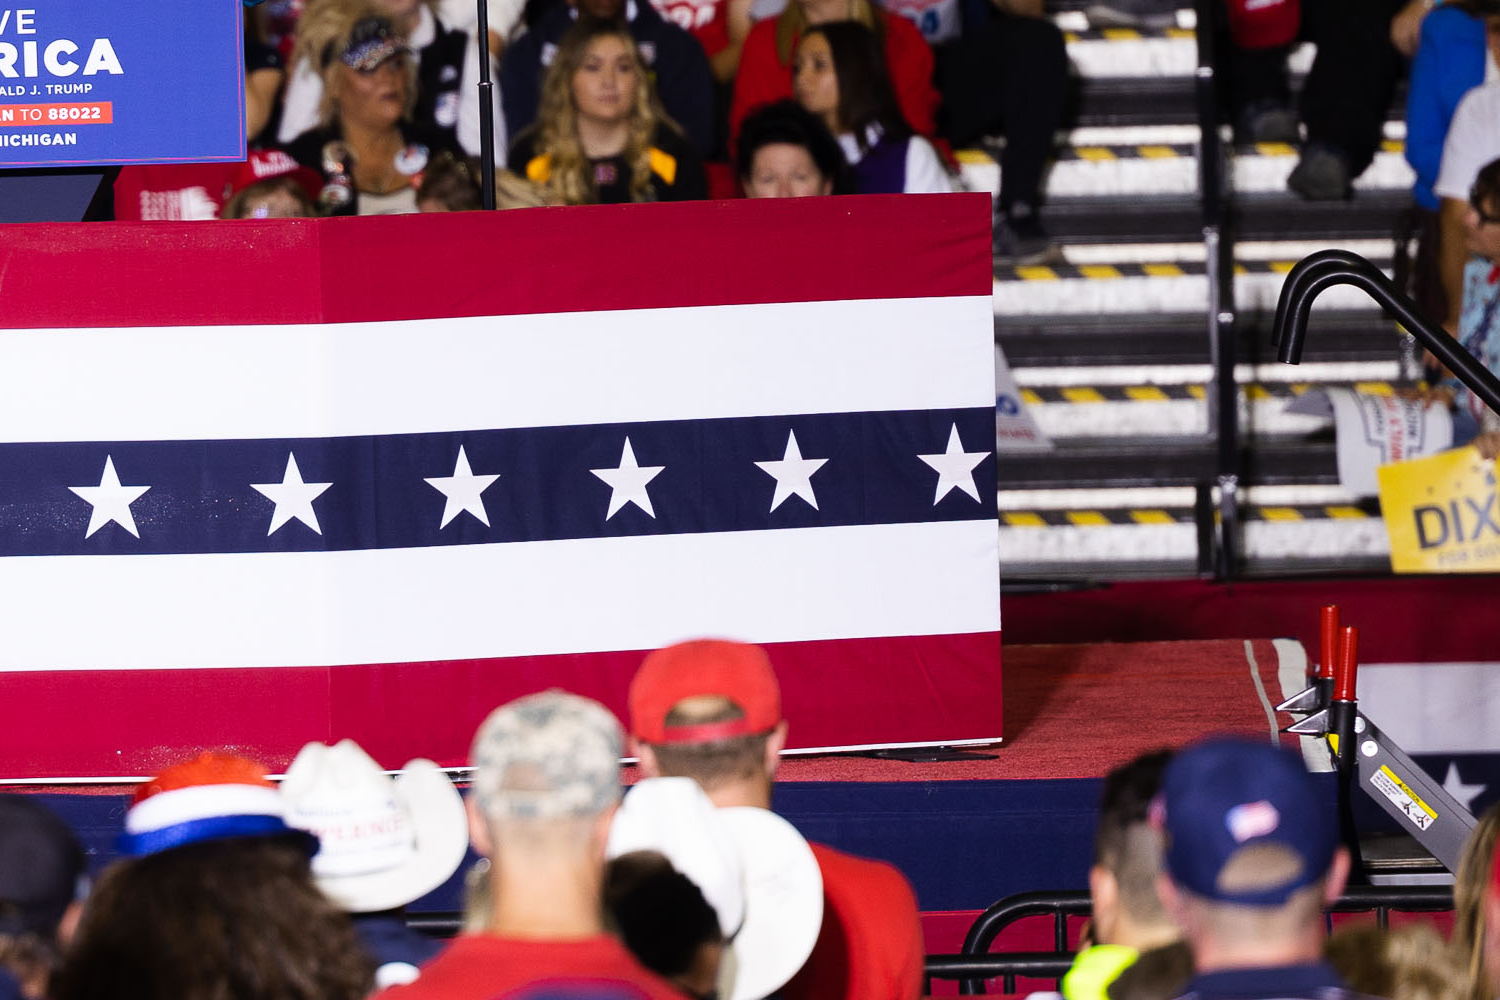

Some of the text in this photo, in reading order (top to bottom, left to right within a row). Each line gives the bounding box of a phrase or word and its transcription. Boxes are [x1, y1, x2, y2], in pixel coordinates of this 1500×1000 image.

[29, 85, 41, 96] J.
[46, 83, 93, 95] TRUMP
[20, 108, 42, 122] TO
[48, 107, 101, 120] 88022
